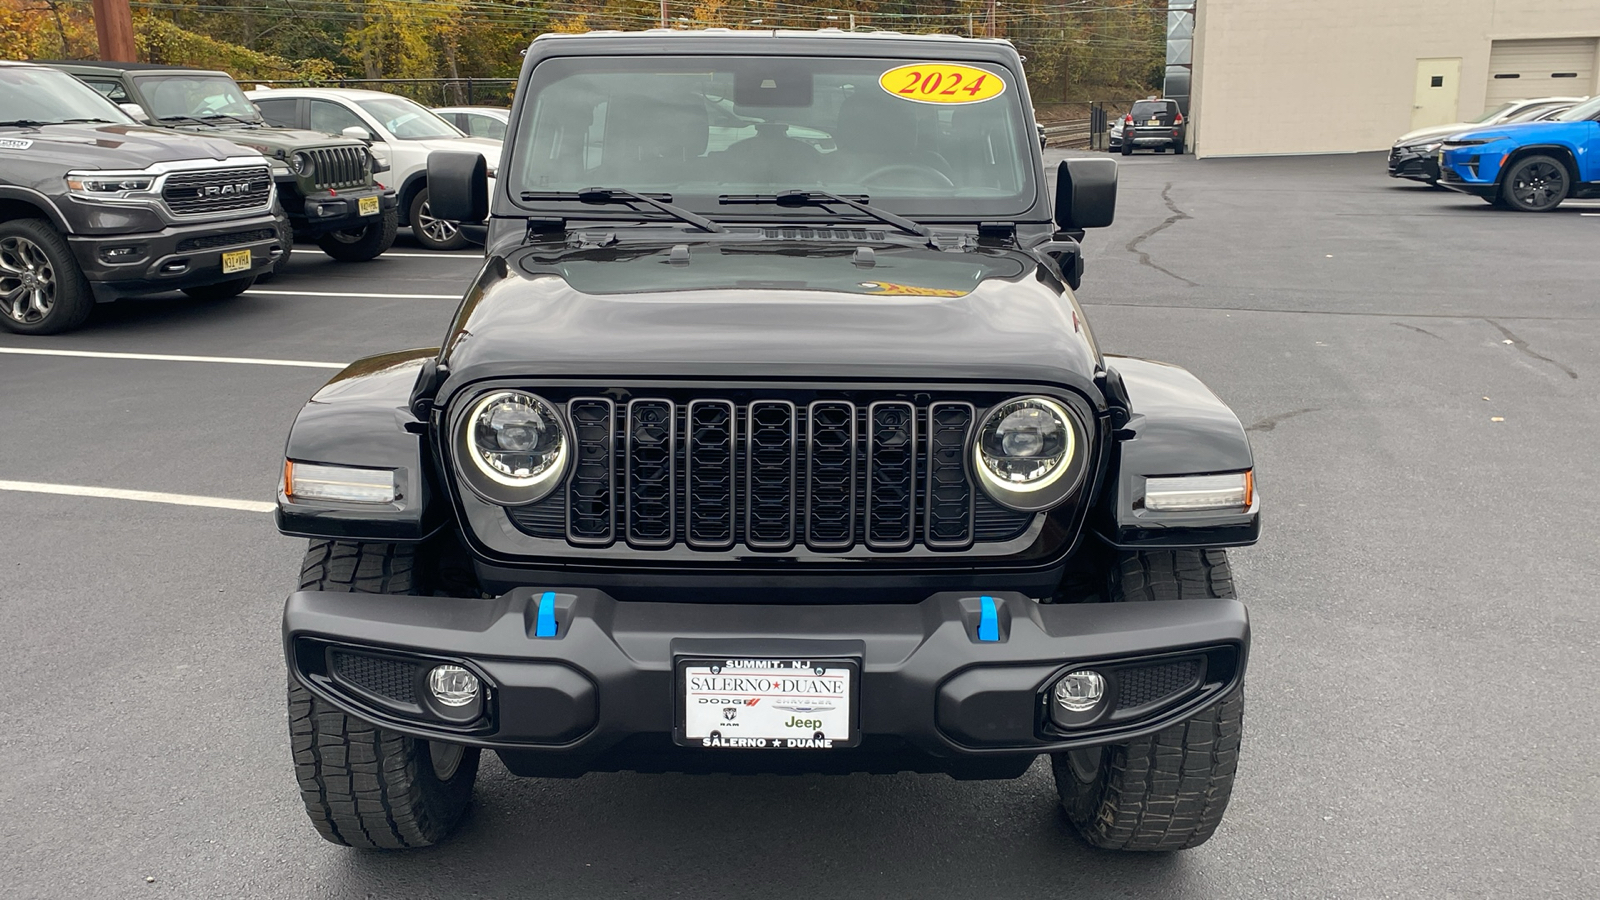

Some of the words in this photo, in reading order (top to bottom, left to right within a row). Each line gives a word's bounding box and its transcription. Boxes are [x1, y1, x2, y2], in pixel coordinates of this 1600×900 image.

[898, 71, 987, 96] 2024
[204, 183, 249, 196] RAM
[792, 661, 811, 669] NJ
[691, 677, 771, 692] SALERNO
[781, 679, 844, 694] DUANE
[785, 716, 823, 730] Jeep
[702, 737, 767, 747] SALERNO
[787, 738, 833, 748] DUANE
